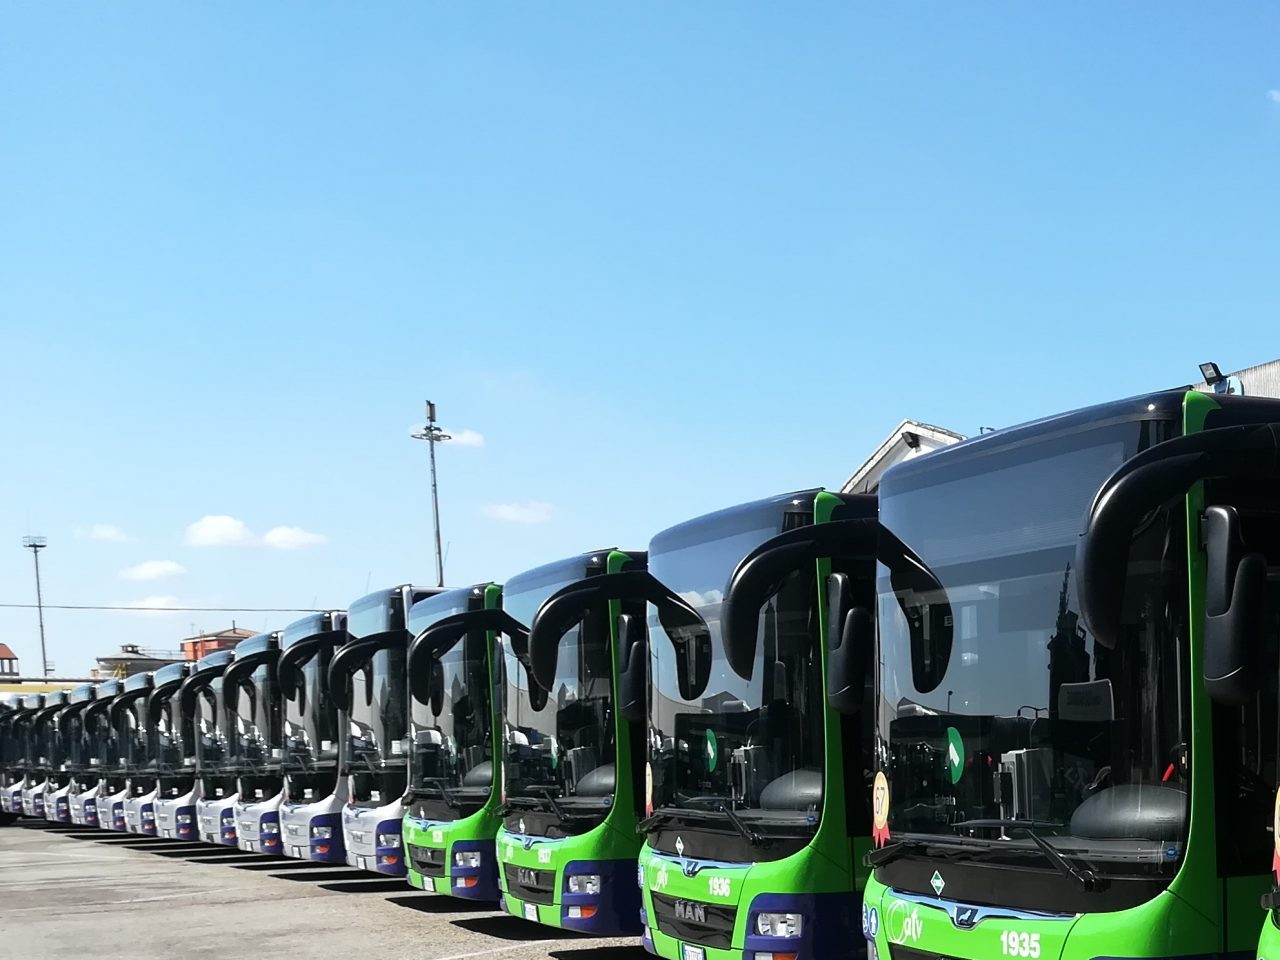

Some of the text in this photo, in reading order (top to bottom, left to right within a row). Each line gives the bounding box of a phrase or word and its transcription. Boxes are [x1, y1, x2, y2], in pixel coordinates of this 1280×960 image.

[708, 876, 731, 897] 1936
[674, 899, 706, 923] MAN
[903, 907, 923, 943] atv
[1000, 930, 1041, 959] 1935
